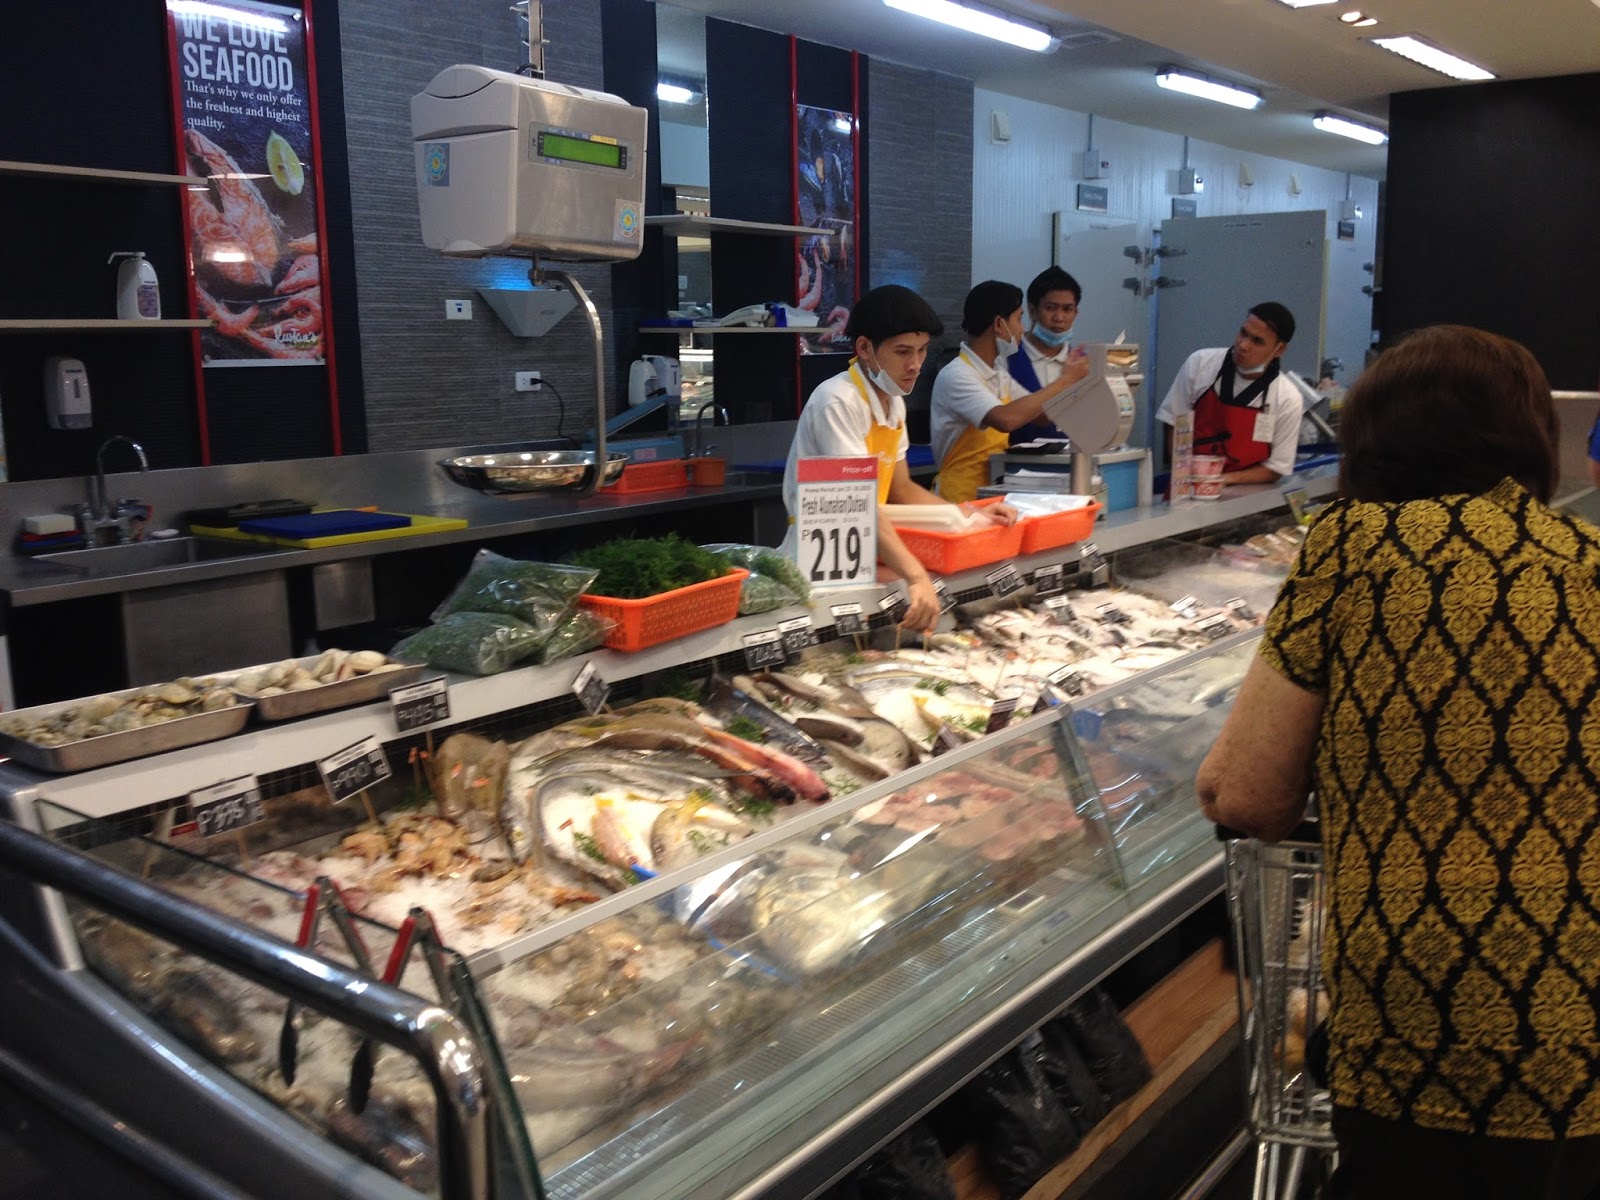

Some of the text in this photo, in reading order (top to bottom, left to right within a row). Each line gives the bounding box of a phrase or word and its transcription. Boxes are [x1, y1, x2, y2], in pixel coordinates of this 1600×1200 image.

[181, 12, 288, 54] WE LOVE
[182, 41, 294, 91] SEAFOOD
[184, 80, 302, 106] That's why we only offer
[186, 97, 301, 122] the freshest and highest
[187, 116, 225, 131] quality.
